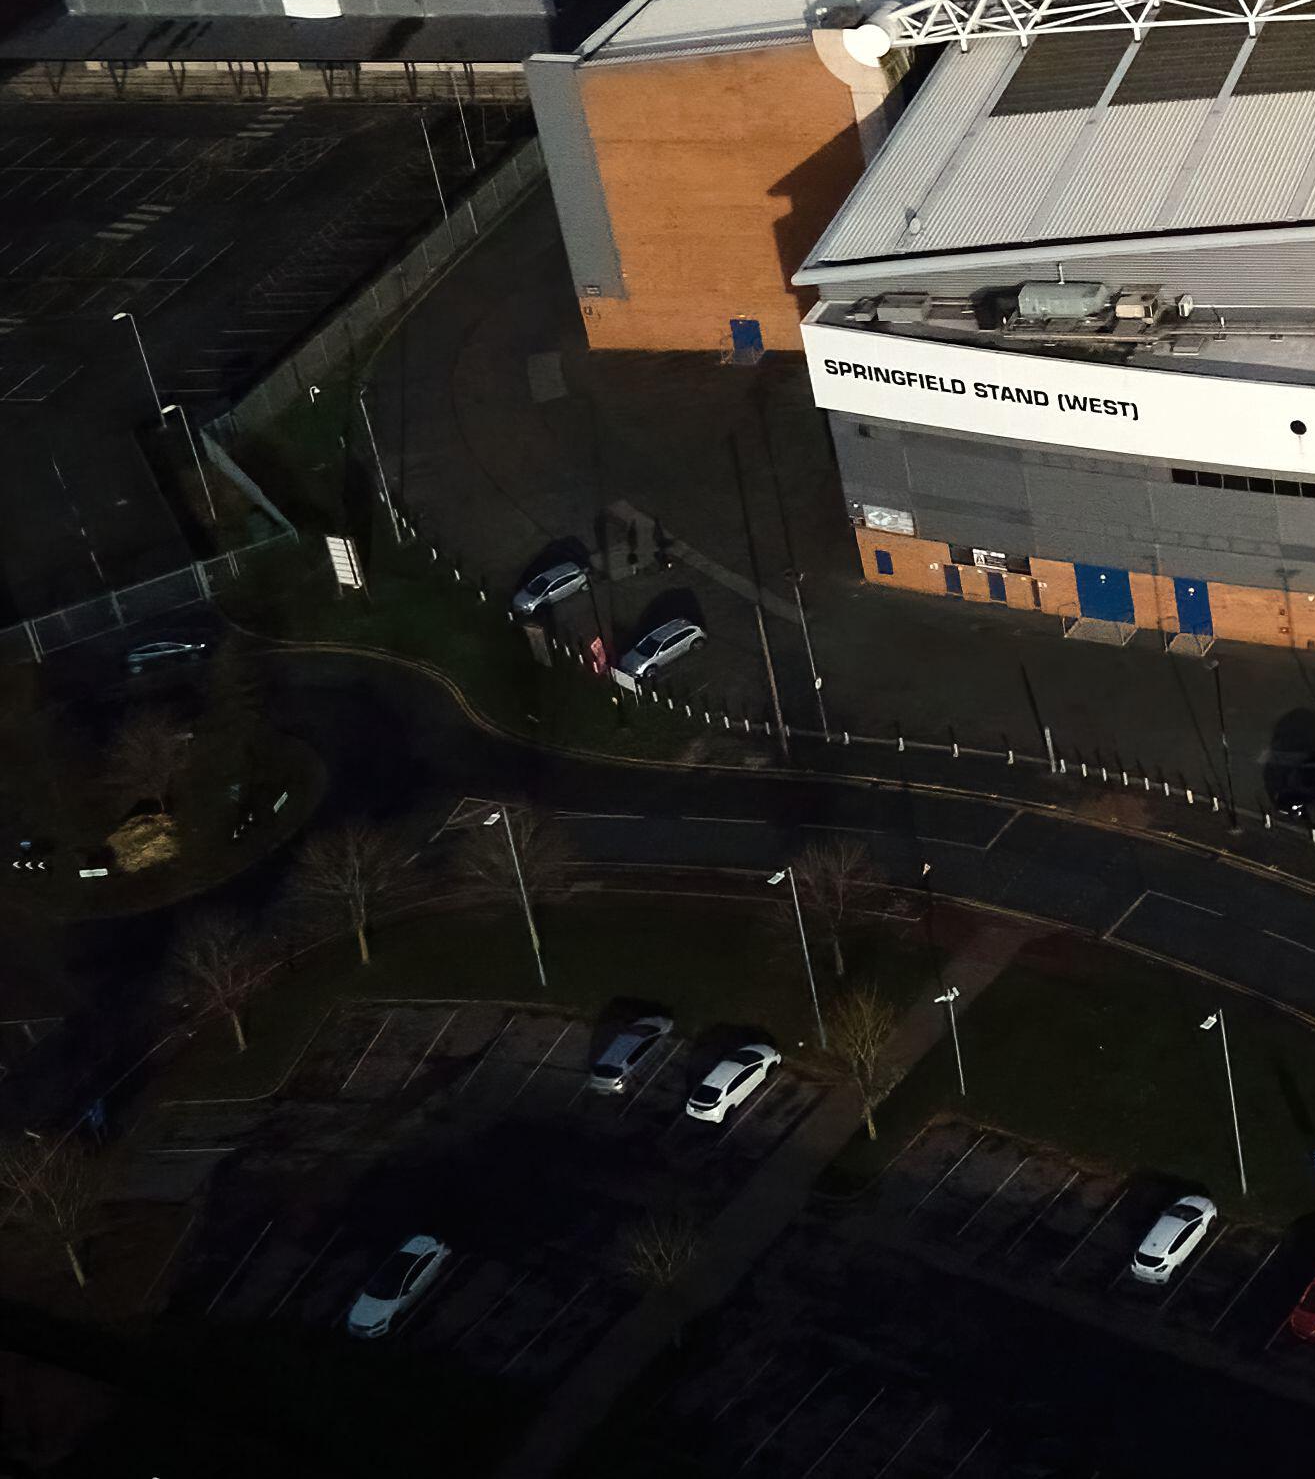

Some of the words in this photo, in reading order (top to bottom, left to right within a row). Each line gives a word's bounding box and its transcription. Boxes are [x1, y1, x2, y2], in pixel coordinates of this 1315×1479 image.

[824, 359, 966, 395] SPRINGFIELD
[973, 382, 1049, 407] STAND
[1058, 393, 1139, 421] (WEST)
